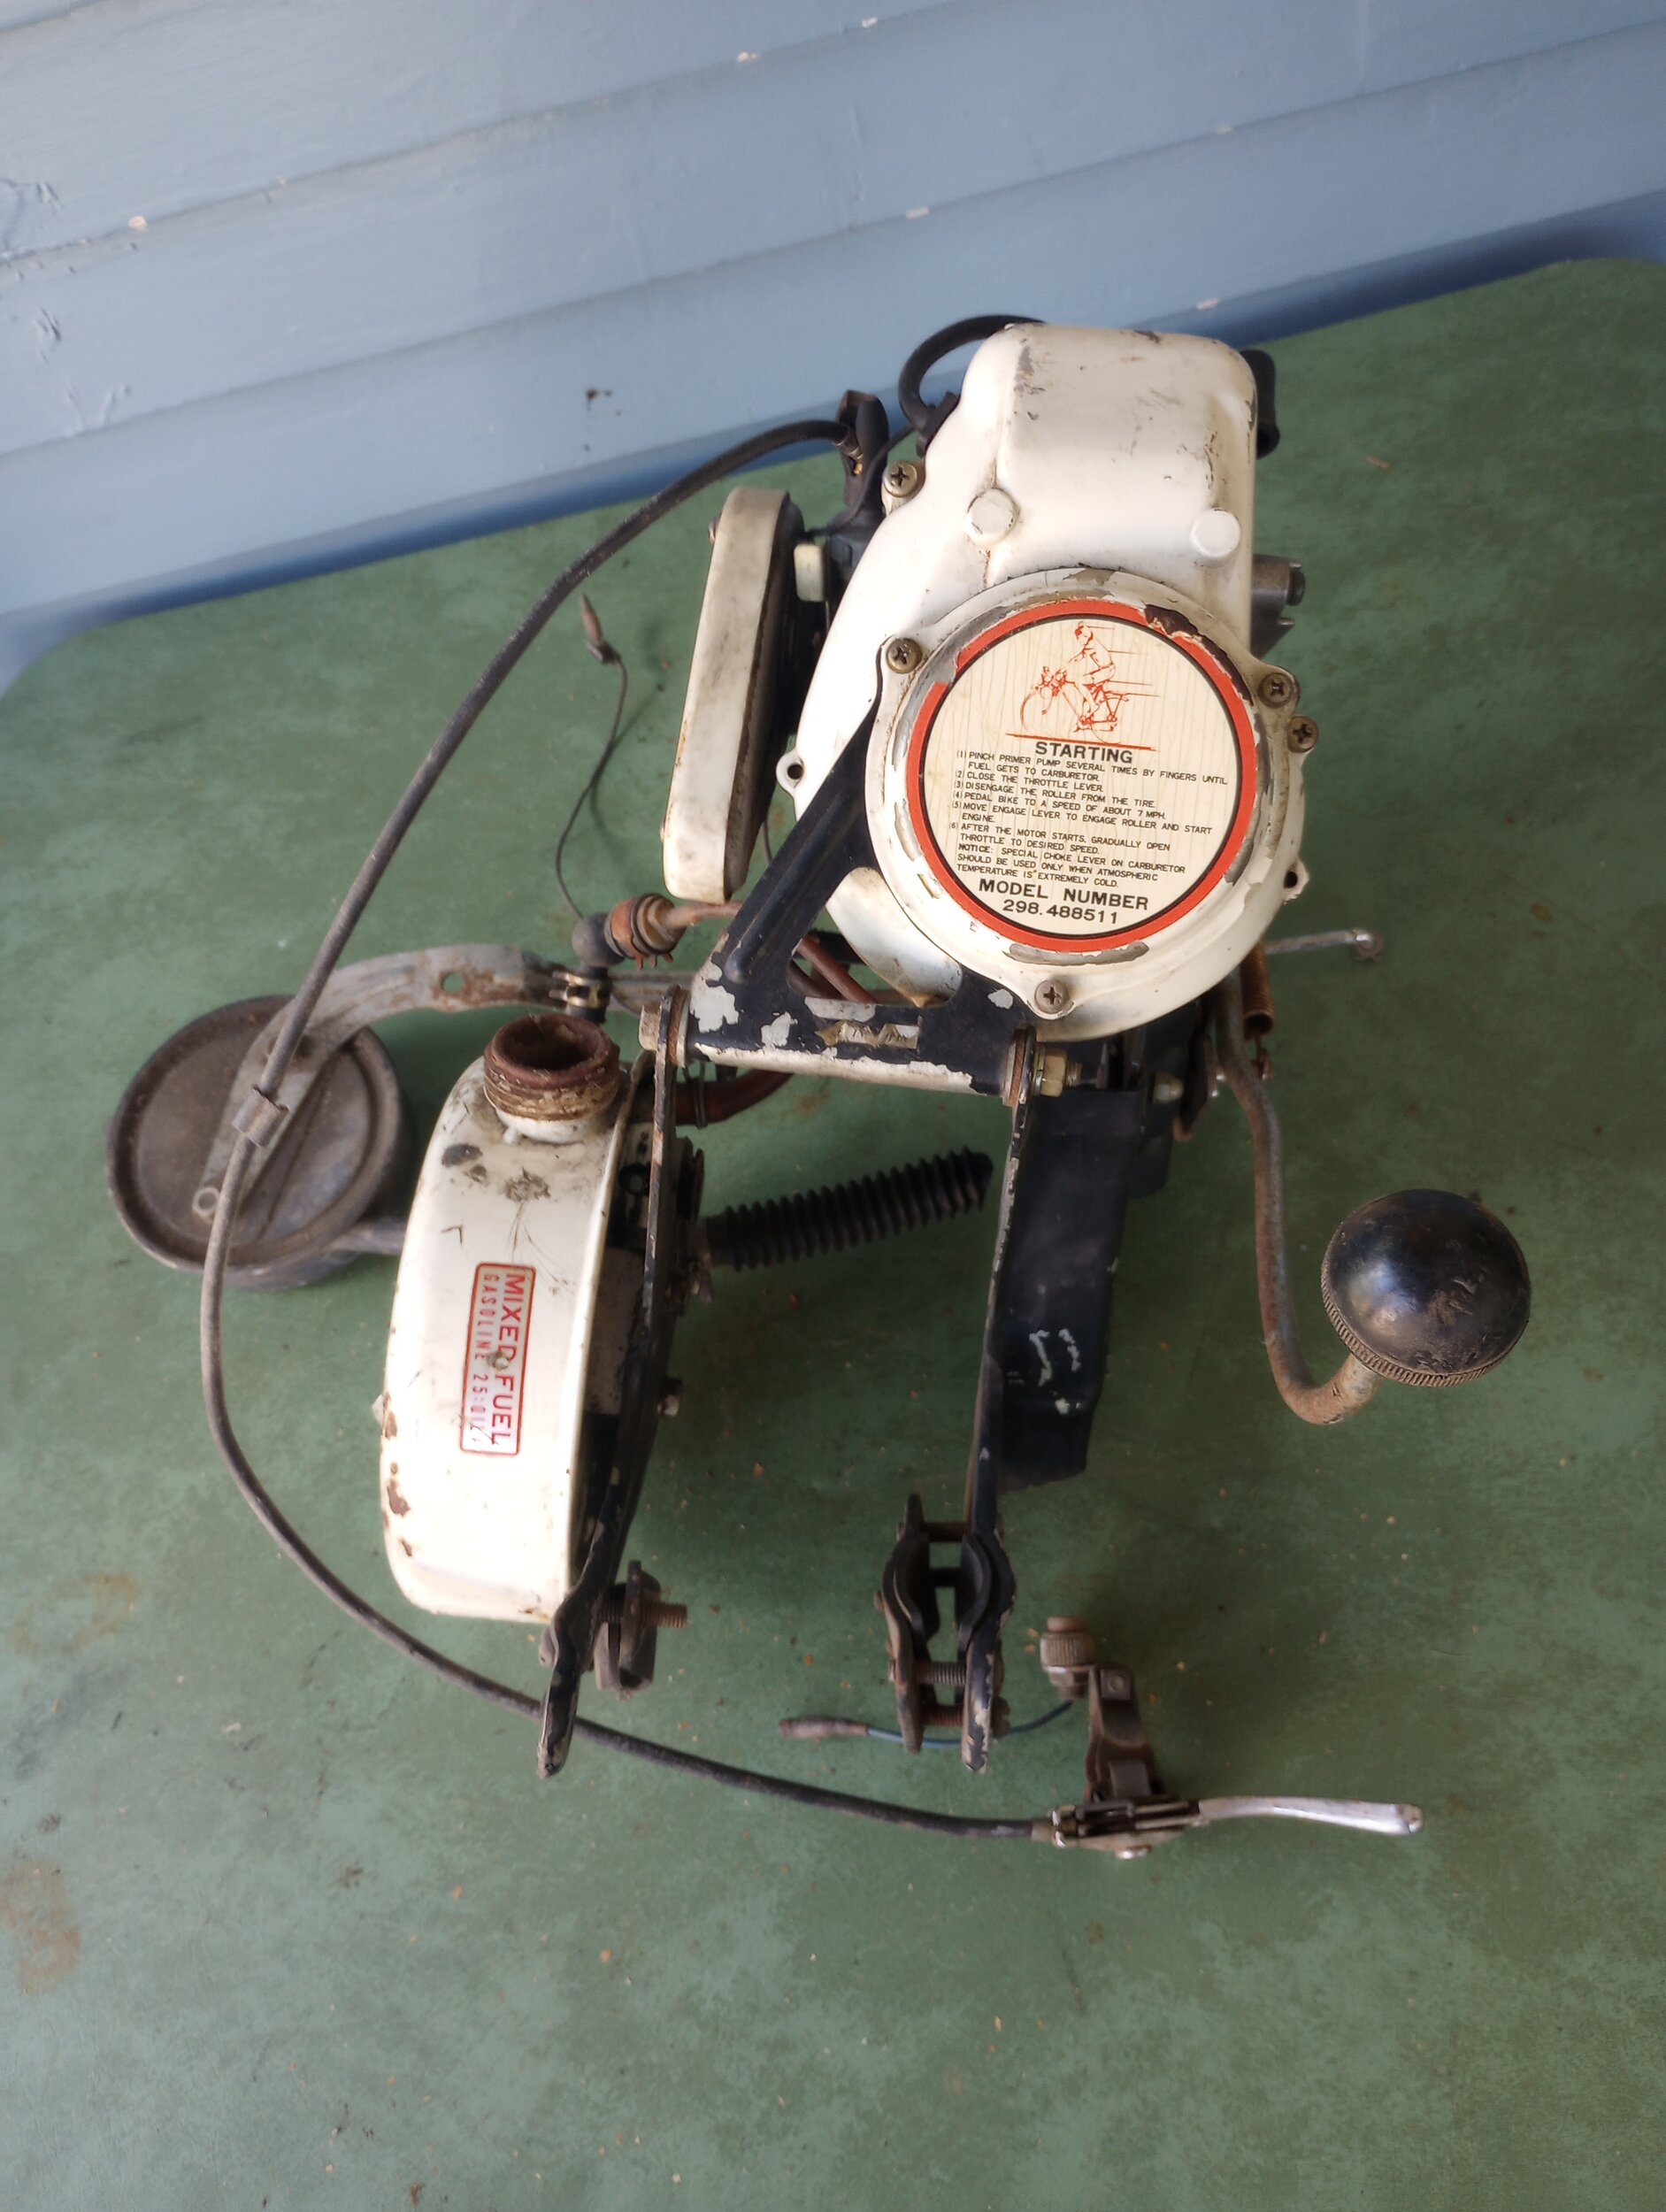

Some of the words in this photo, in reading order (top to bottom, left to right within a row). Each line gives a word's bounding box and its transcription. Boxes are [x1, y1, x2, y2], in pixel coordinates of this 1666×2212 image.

[1035, 741, 1132, 764] STARTING
[967, 772, 995, 781] CLOSE
[1002, 774, 1017, 783] THE
[1024, 777, 1068, 788] THROTTLE
[968, 762, 991, 771] FUEL
[996, 764, 1018, 773] GETS
[969, 751, 994, 760] PINCH
[999, 754, 1031, 764] PRIMER
[1066, 761, 1105, 772] SEVERAL
[1111, 766, 1138, 775] TIMES
[1160, 771, 1196, 781] FINGERS
[1202, 775, 1228, 785] UNTIL
[964, 792, 993, 802] PEDAL
[1053, 801, 1080, 810] SPEED
[1103, 806, 1132, 816] ABOUT
[965, 781, 1014, 793] DISENGAGE
[1020, 787, 1037, 796] THE
[1042, 790, 1076, 800] ROLLER
[1081, 794, 1105, 803] FROM
[1111, 796, 1128, 805] THE
[963, 803, 987, 812] MOVE
[993, 805, 1026, 816] ENGAGE
[1032, 810, 1060, 819] LEVER
[1083, 815, 1117, 825] ENGAGE
[1122, 819, 1156, 828] ROLLER
[1185, 826, 1212, 834] START
[960, 833, 1005, 844] THROTTLE
[1027, 840, 1064, 851] DESIRED
[961, 823, 989, 833] AFTER
[1017, 828, 1047, 838] MOTOR
[1091, 836, 1141, 848] GRADUALLY
[1147, 842, 1170, 851] OPEN
[957, 853, 991, 864] SHOULD
[1013, 860, 1036, 869] USED
[1069, 865, 1093, 874] WHEN
[1097, 869, 1158, 881] ATMOSPHERIC
[959, 843, 994, 854] NOTICE:
[1002, 848, 1038, 858] SPECIAL
[1044, 852, 1071, 862] CHOKE
[1078, 856, 1106, 865] LEVER
[1128, 861, 1186, 873] CARBURETOR
[957, 864, 1017, 877] TEMPERATURE
[1038, 872, 1089, 884] EXTREMELY
[979, 879, 1048, 899] MODEL
[1063, 888, 1148, 910] NUMBER
[1002, 899, 1117, 925] 298.488511
[474, 1273, 499, 1360] GASOLINE
[498, 1273, 526, 1363] MIXED
[491, 1374, 514, 1445] FUEL
